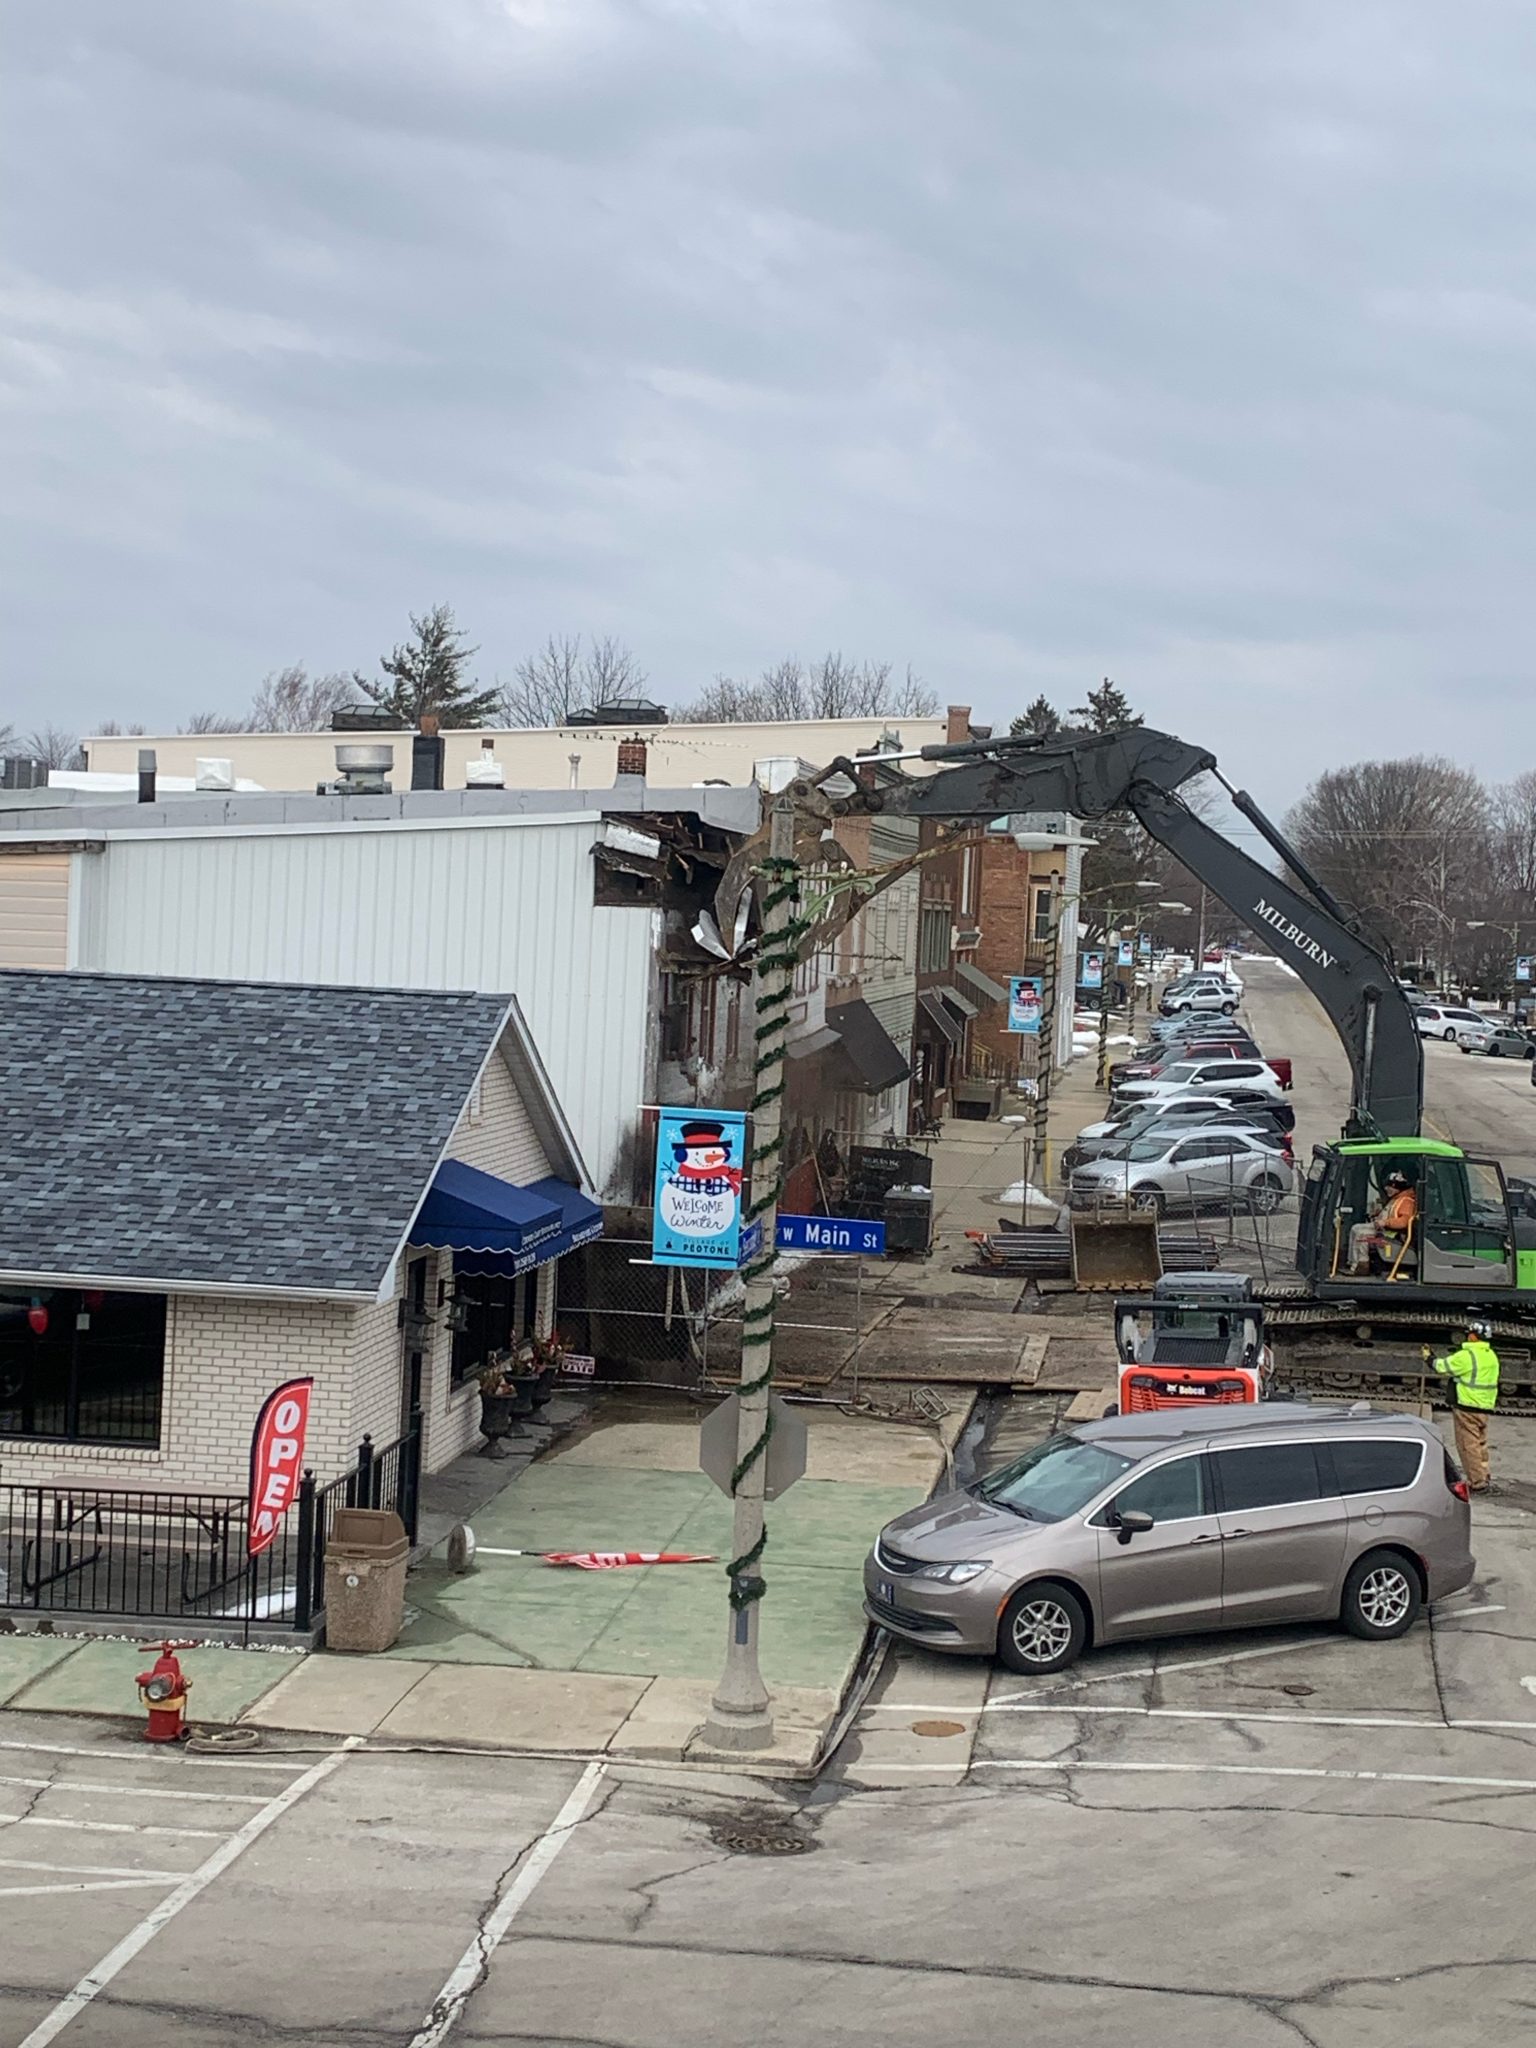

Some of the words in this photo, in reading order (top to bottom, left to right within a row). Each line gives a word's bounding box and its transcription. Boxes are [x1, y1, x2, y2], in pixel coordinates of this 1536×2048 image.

[1252, 898, 1336, 968] MILBURN
[671, 1197, 724, 1214] WELCOME
[670, 1214, 725, 1230] Winter
[783, 1227, 793, 1241] W
[805, 1223, 850, 1246] Main
[862, 1233, 878, 1248] St
[683, 1244, 730, 1254] PEOTONE
[1178, 1384, 1206, 1396] Bobcat
[251, 1400, 301, 1537] OPEN
